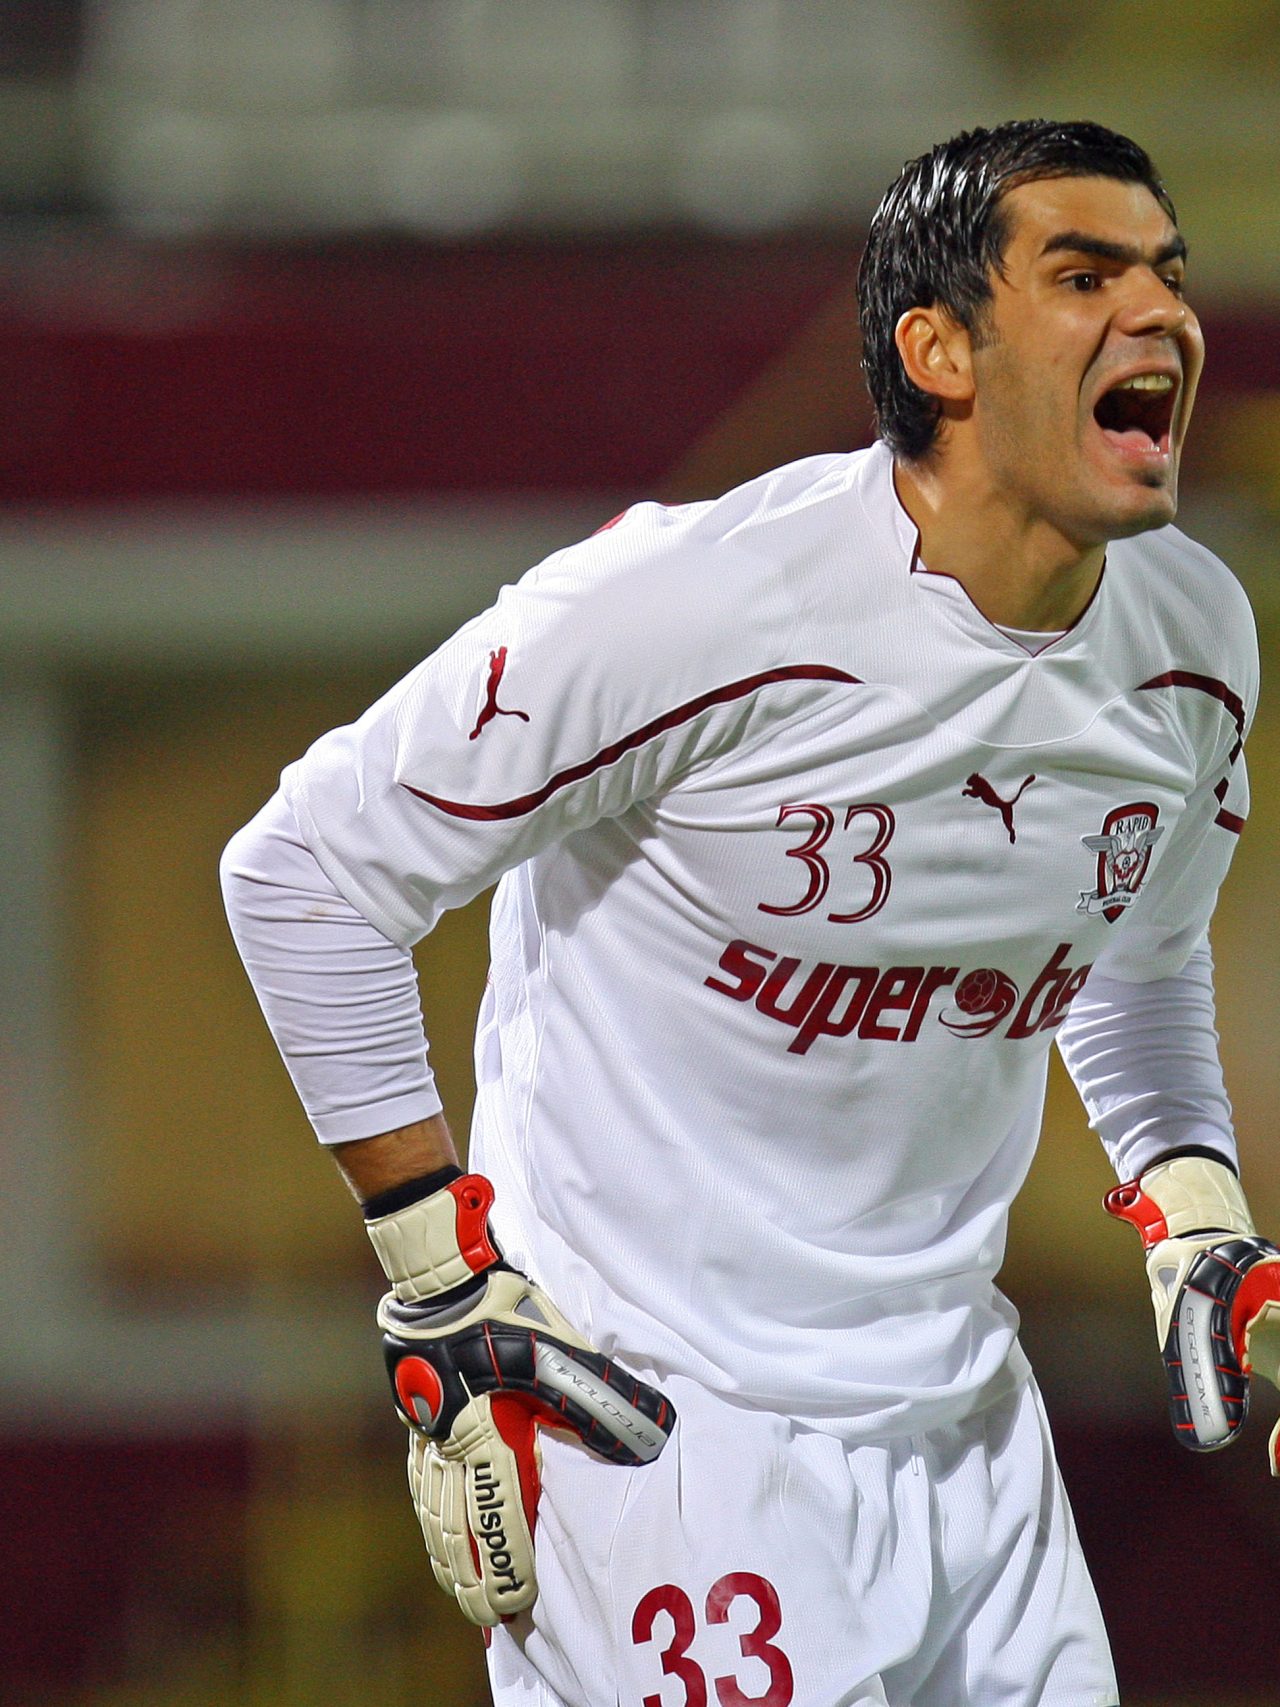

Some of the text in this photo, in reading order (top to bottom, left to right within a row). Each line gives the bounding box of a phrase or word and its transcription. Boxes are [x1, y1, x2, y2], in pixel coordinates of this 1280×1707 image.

[757, 803, 896, 924] 33
[1116, 816, 1149, 835] RAPID
[704, 939, 961, 1056] super
[474, 1461, 525, 1595] uhlsport
[632, 1571, 794, 1707] 33
